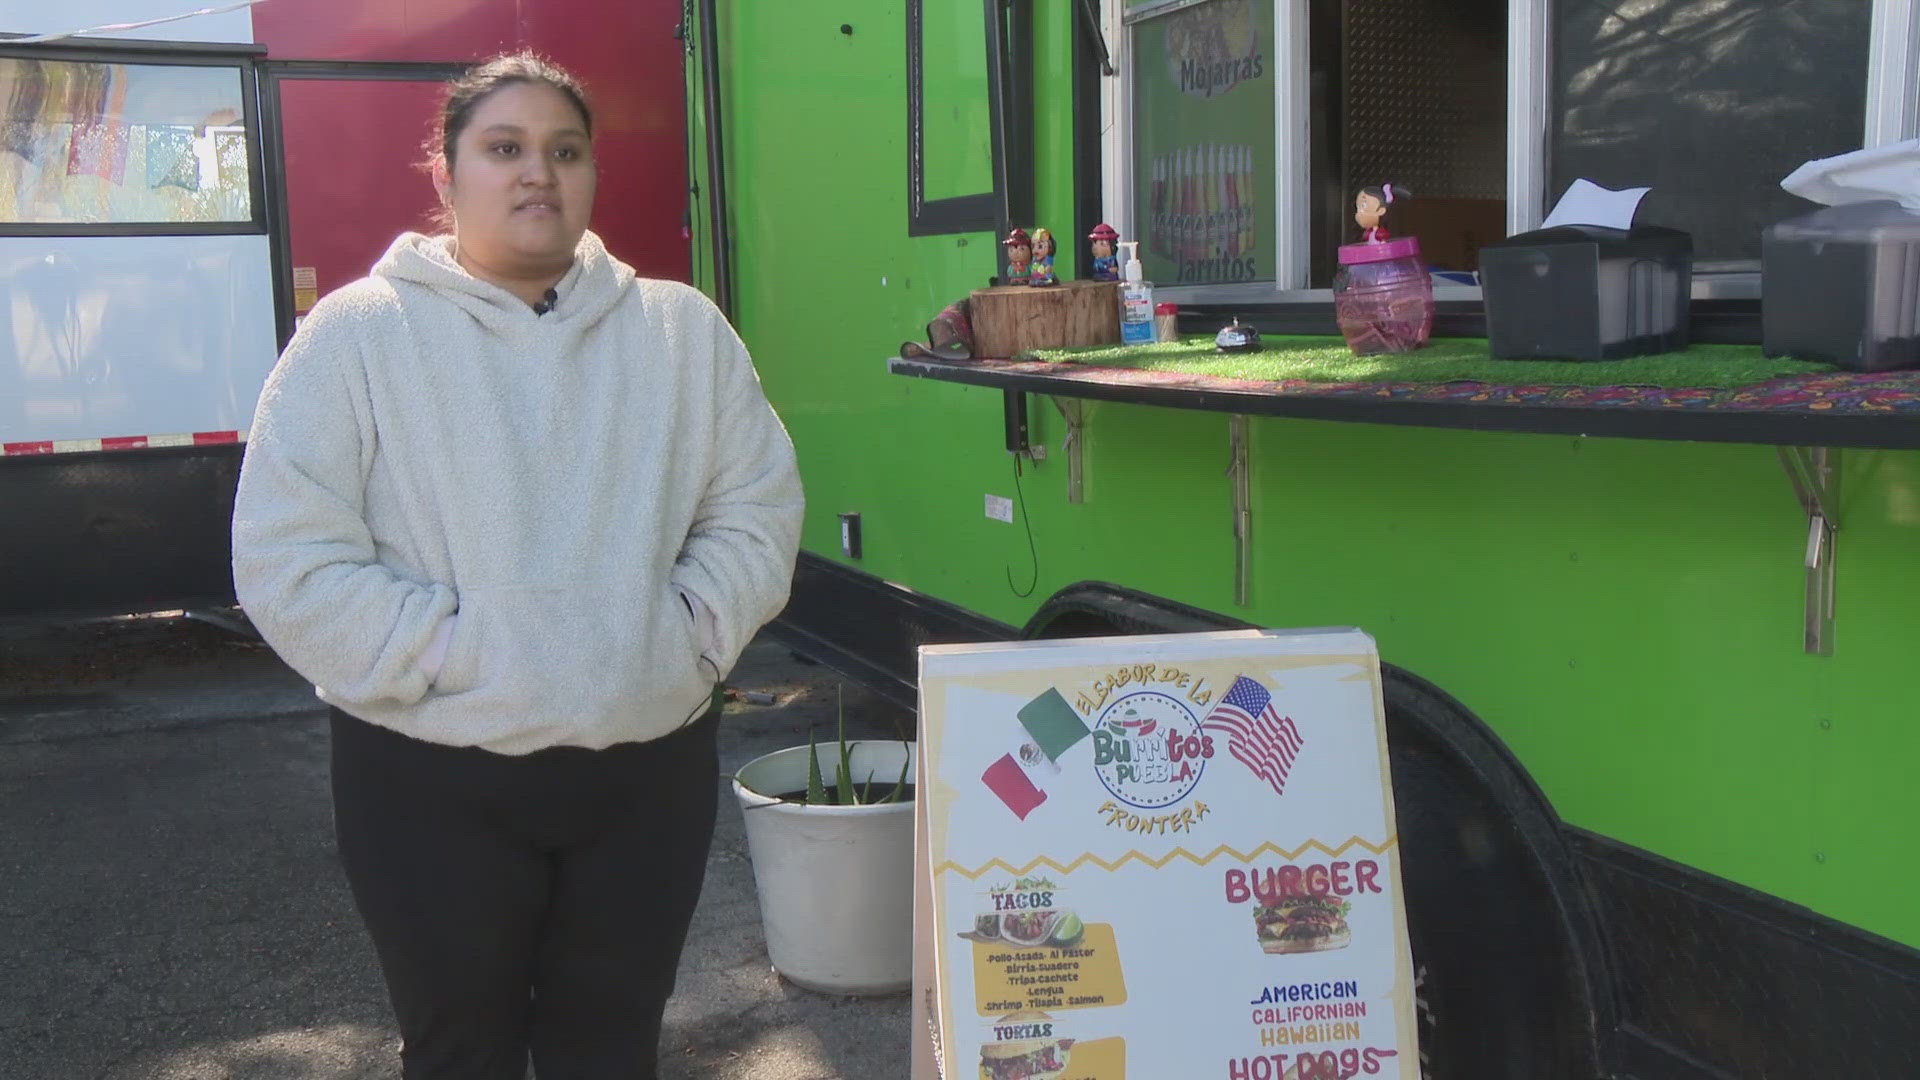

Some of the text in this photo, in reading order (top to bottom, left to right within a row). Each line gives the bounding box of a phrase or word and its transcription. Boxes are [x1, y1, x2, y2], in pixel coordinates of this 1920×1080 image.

[1181, 55, 1263, 96] Mojarras
[1177, 247, 1256, 281] Jarritos
[1075, 663, 1212, 717] EL SABOR DE LA
[1091, 728, 1215, 766] Burritos
[1116, 761, 1194, 785] PUEBLA
[1098, 800, 1211, 836] FRONTERA
[1225, 859, 1383, 904] BURGER
[991, 891, 1054, 911] TACOS
[994, 1023, 1053, 1041] TORTAS
[1229, 1054, 1288, 1080] HOT
